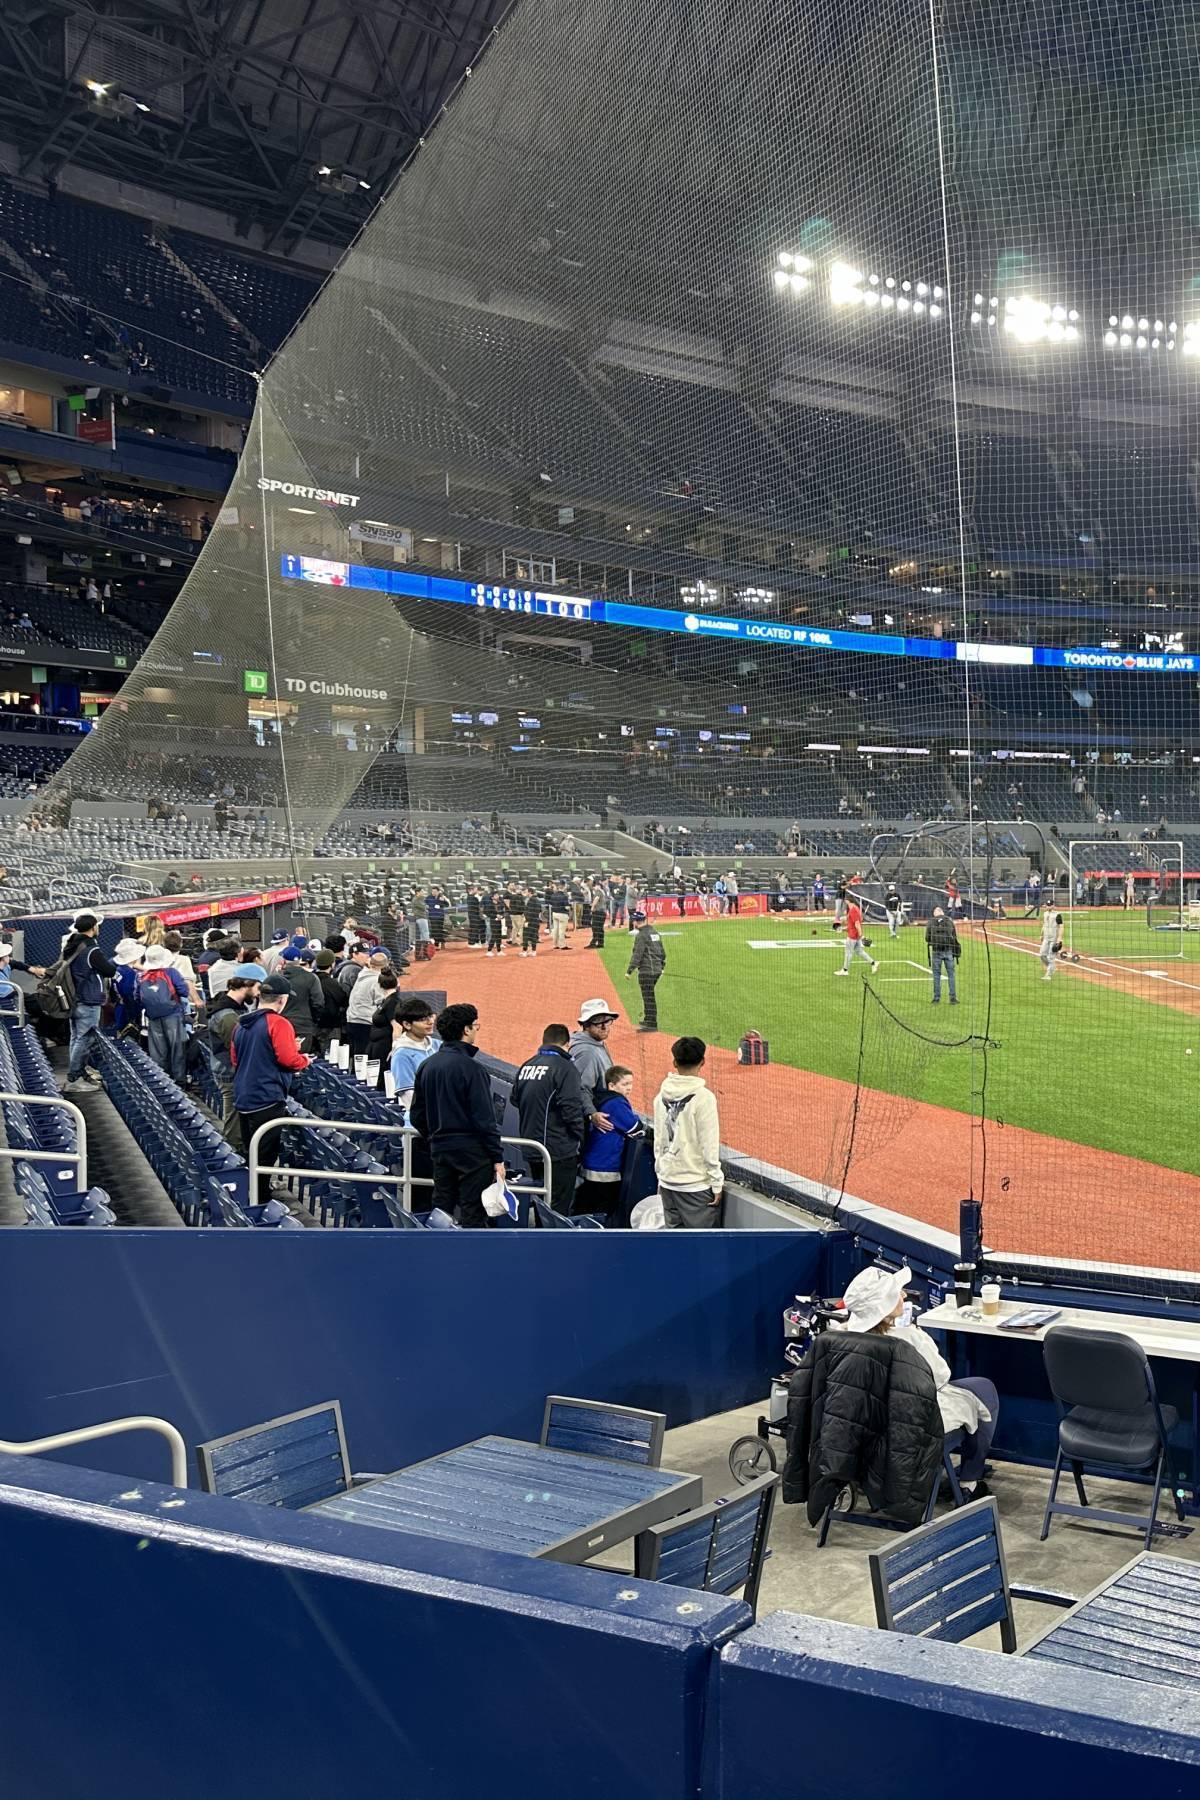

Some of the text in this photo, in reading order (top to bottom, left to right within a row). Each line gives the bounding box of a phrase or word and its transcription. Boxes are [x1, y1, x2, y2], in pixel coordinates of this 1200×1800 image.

[257, 477, 360, 507] SPORTSNET
[358, 525, 402, 539] SN590
[746, 625, 792, 640] LOCATED
[0, 645, 26, 656] house
[1064, 653, 1194, 669] TORONTO BLUE JAYS
[247, 674, 267, 689] TD
[286, 678, 388, 700] TD Clubhouse
[518, 1064, 549, 1081] STAFF
